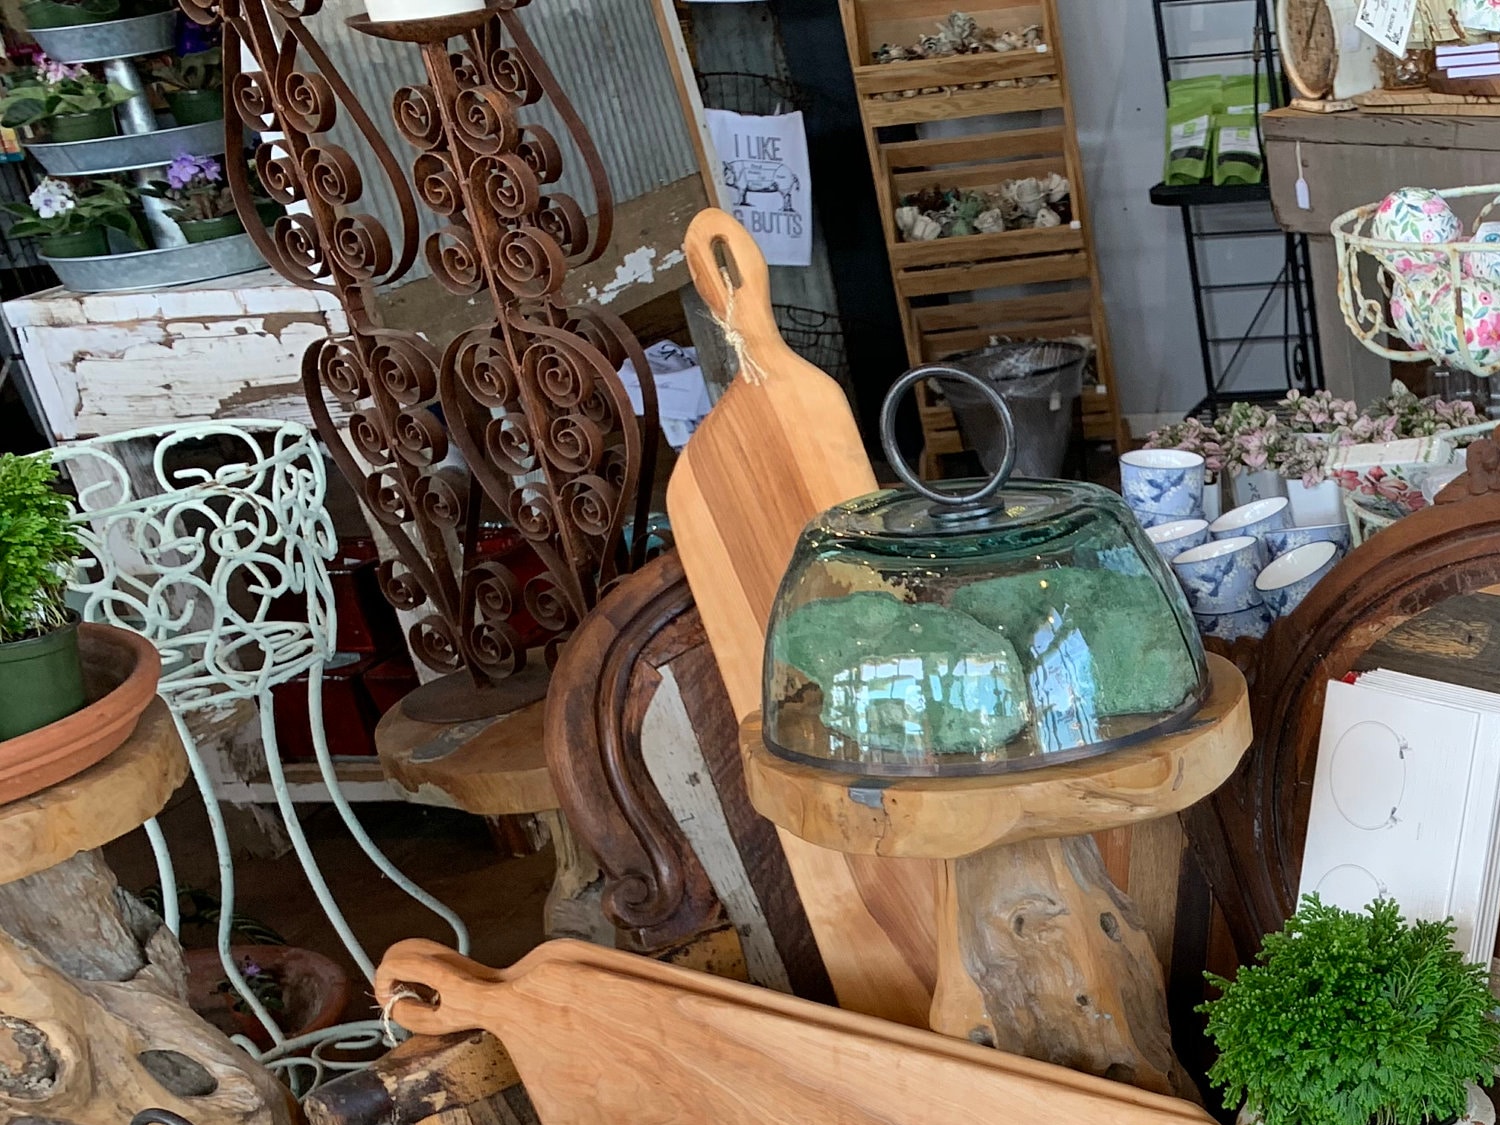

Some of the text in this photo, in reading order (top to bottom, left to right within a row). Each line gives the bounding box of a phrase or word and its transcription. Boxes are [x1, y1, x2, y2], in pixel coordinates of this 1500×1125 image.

[733, 133, 783, 161] I LIKE
[751, 210, 803, 236] BUTTS
